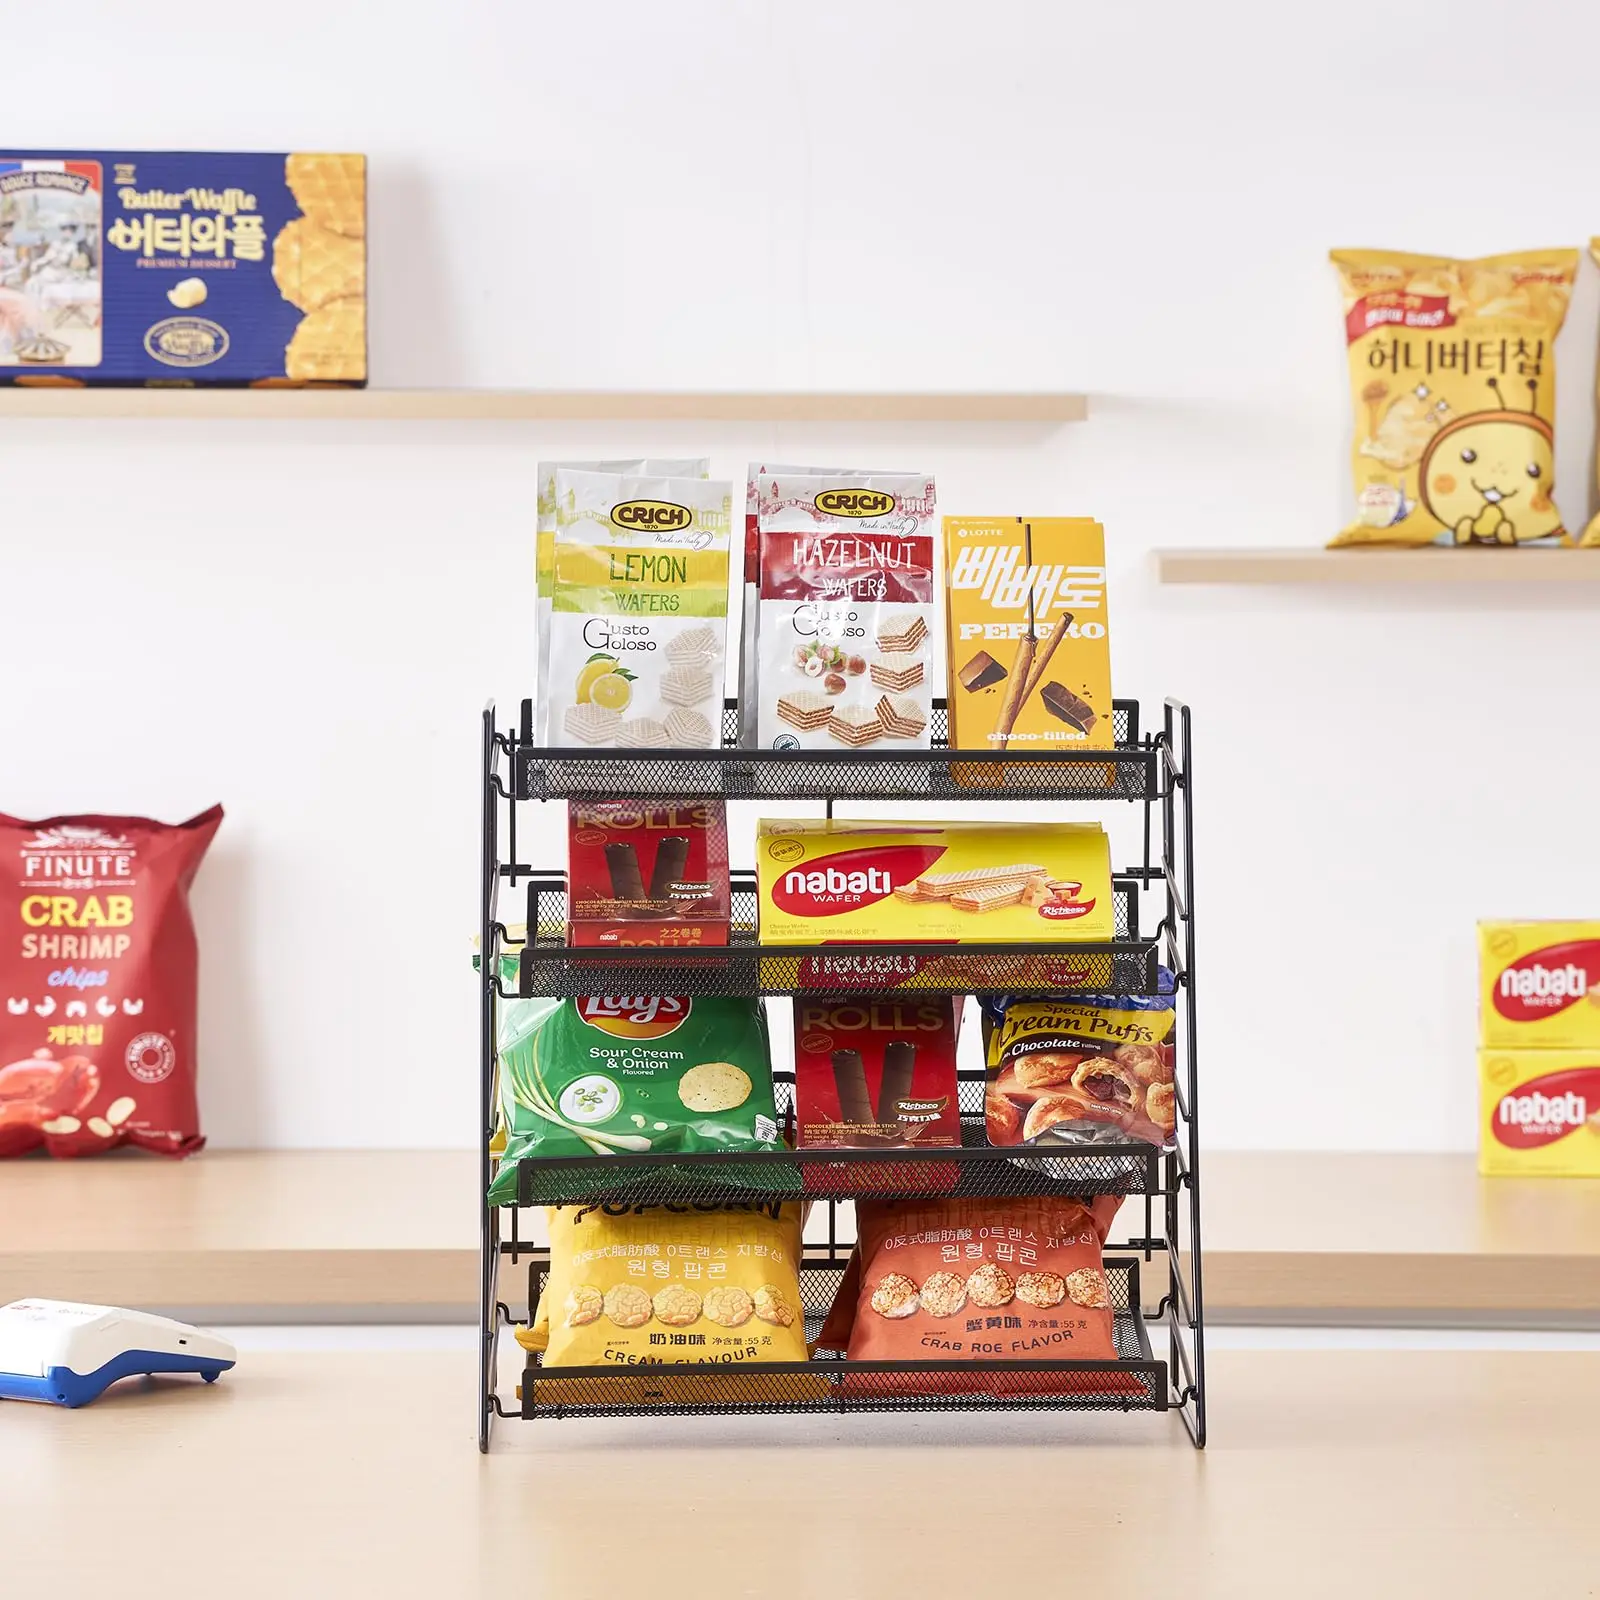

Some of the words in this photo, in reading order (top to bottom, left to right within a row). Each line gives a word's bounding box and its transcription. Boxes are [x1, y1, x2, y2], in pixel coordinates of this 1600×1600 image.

[118, 187, 184, 210] Butter
[184, 188, 257, 215] Waffle
[107, 212, 268, 261] 버터와플
[1369, 338, 1545, 376] 허니버터칩
[821, 494, 888, 511] CRICH
[618, 506, 684, 526] CRICH
[858, 518, 880, 529] Made
[969, 528, 1004, 536] LOTTE
[793, 538, 917, 569] HAZELNUT
[609, 554, 687, 583] LEMON
[822, 578, 888, 598] WAFERS
[952, 545, 1106, 619] 빼빼로
[614, 594, 680, 612] WAFERS
[986, 732, 1087, 741] choco-filled
[26, 855, 131, 877] FINUTE
[786, 867, 891, 894] nabati
[813, 894, 861, 903] WAFER
[21, 896, 134, 927] CRAB
[22, 935, 131, 959] SHRIMP
[47, 967, 108, 991] chips
[1501, 964, 1586, 997] nabati
[585, 996, 681, 1023] Lays
[802, 1006, 944, 1032] ROLLS
[1043, 1003, 1101, 1018] Special
[1089, 1017, 1154, 1043] Puffs
[590, 1047, 628, 1059] Sour
[631, 1047, 684, 1060] Cream
[1012, 1038, 1081, 1056] Chocolate
[606, 1058, 619, 1069] &
[622, 1058, 669, 1069] Onion
[898, 1102, 938, 1111] Richoco
[1500, 1092, 1585, 1125] nabati
[885, 1228, 973, 1250] 0反式脂肪酸
[737, 1244, 783, 1264] 지방산
[965, 1316, 1022, 1332] 蟹黄味
[650, 1333, 706, 1345] 奶油味
[920, 1336, 962, 1351] CRAB
[971, 1342, 1003, 1353] ROE
[1012, 1329, 1074, 1352] FLAVOR
[604, 1349, 664, 1365] CREAM
